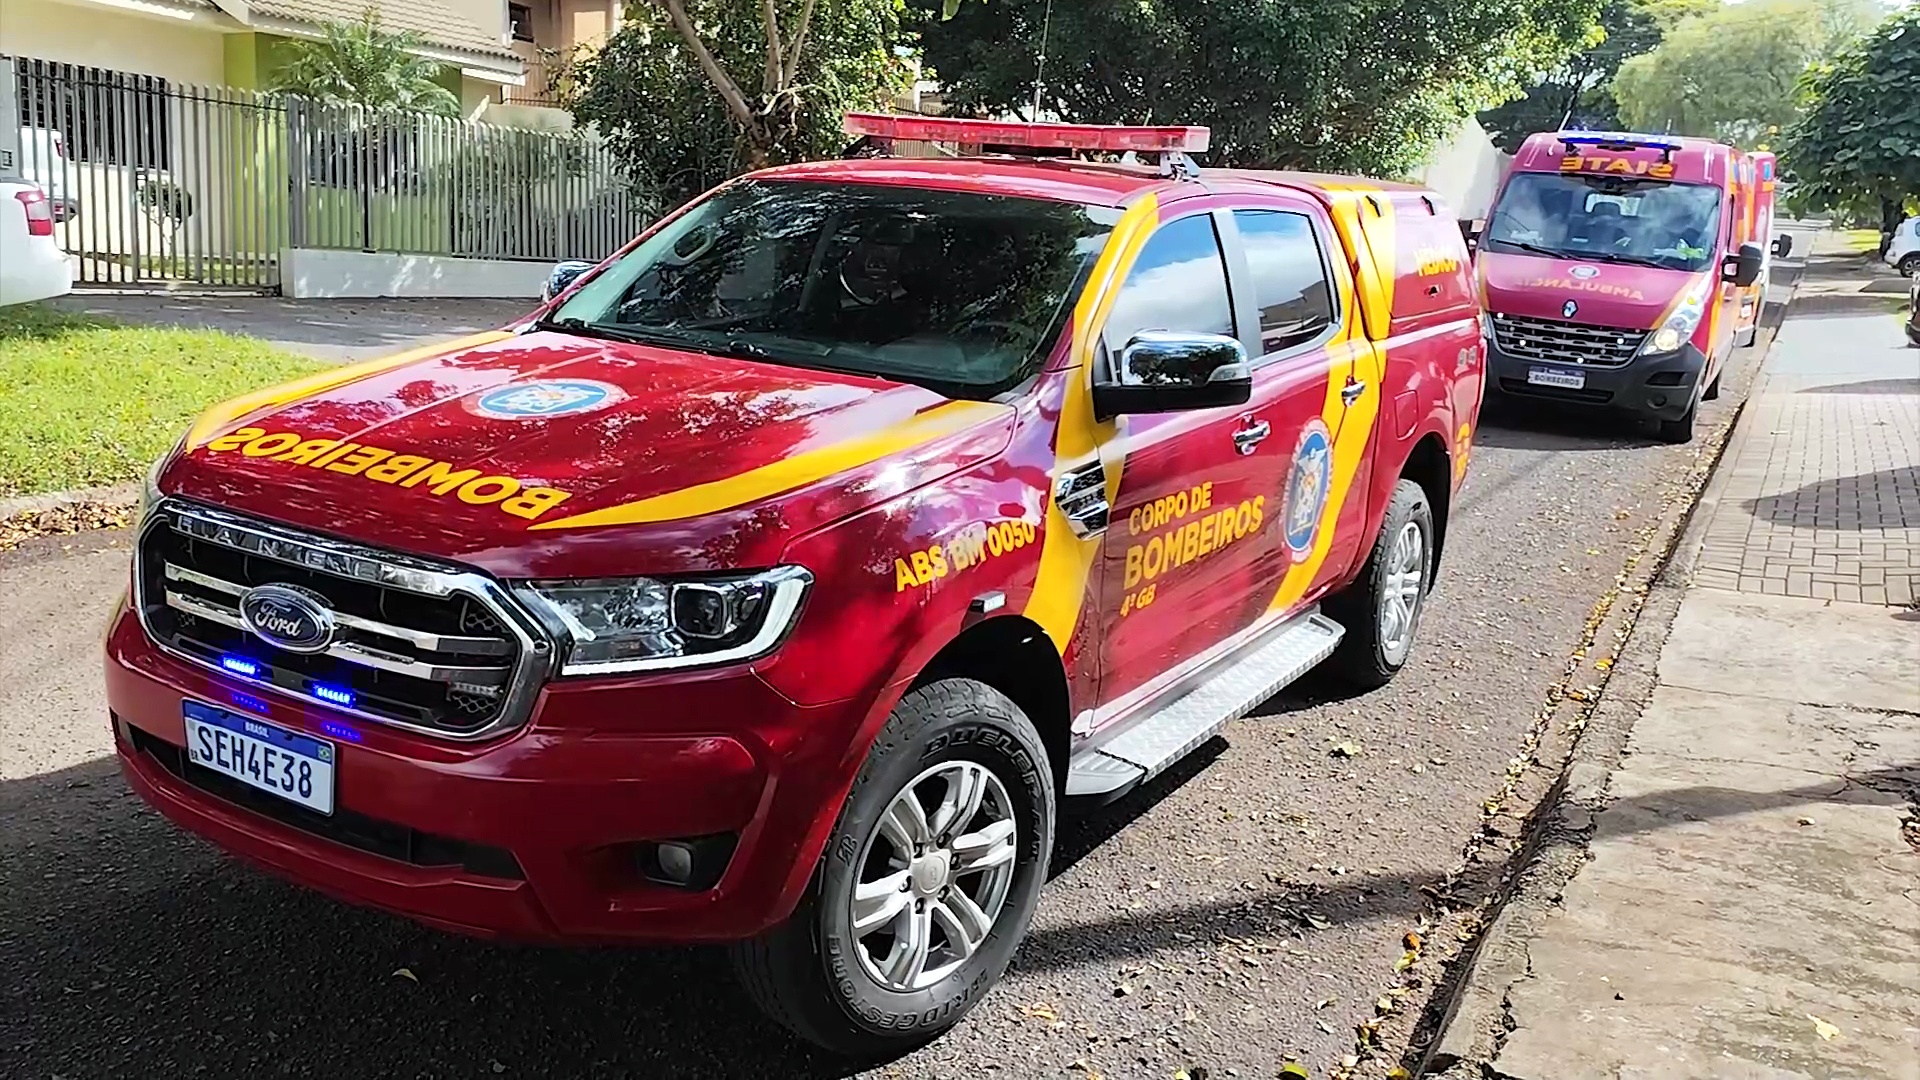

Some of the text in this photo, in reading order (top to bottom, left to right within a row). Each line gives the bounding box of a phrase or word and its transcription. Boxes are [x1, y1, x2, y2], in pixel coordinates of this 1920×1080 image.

[1129, 481, 1213, 536] CORPO DE
[894, 518, 1036, 593] ABS BM 0050
[1123, 494, 1265, 591] BOMBEIROS
[254, 600, 304, 637] Ford
[1136, 583, 1157, 610] GB
[243, 720, 270, 738] BRASIL
[197, 725, 312, 799] SEH4E38
